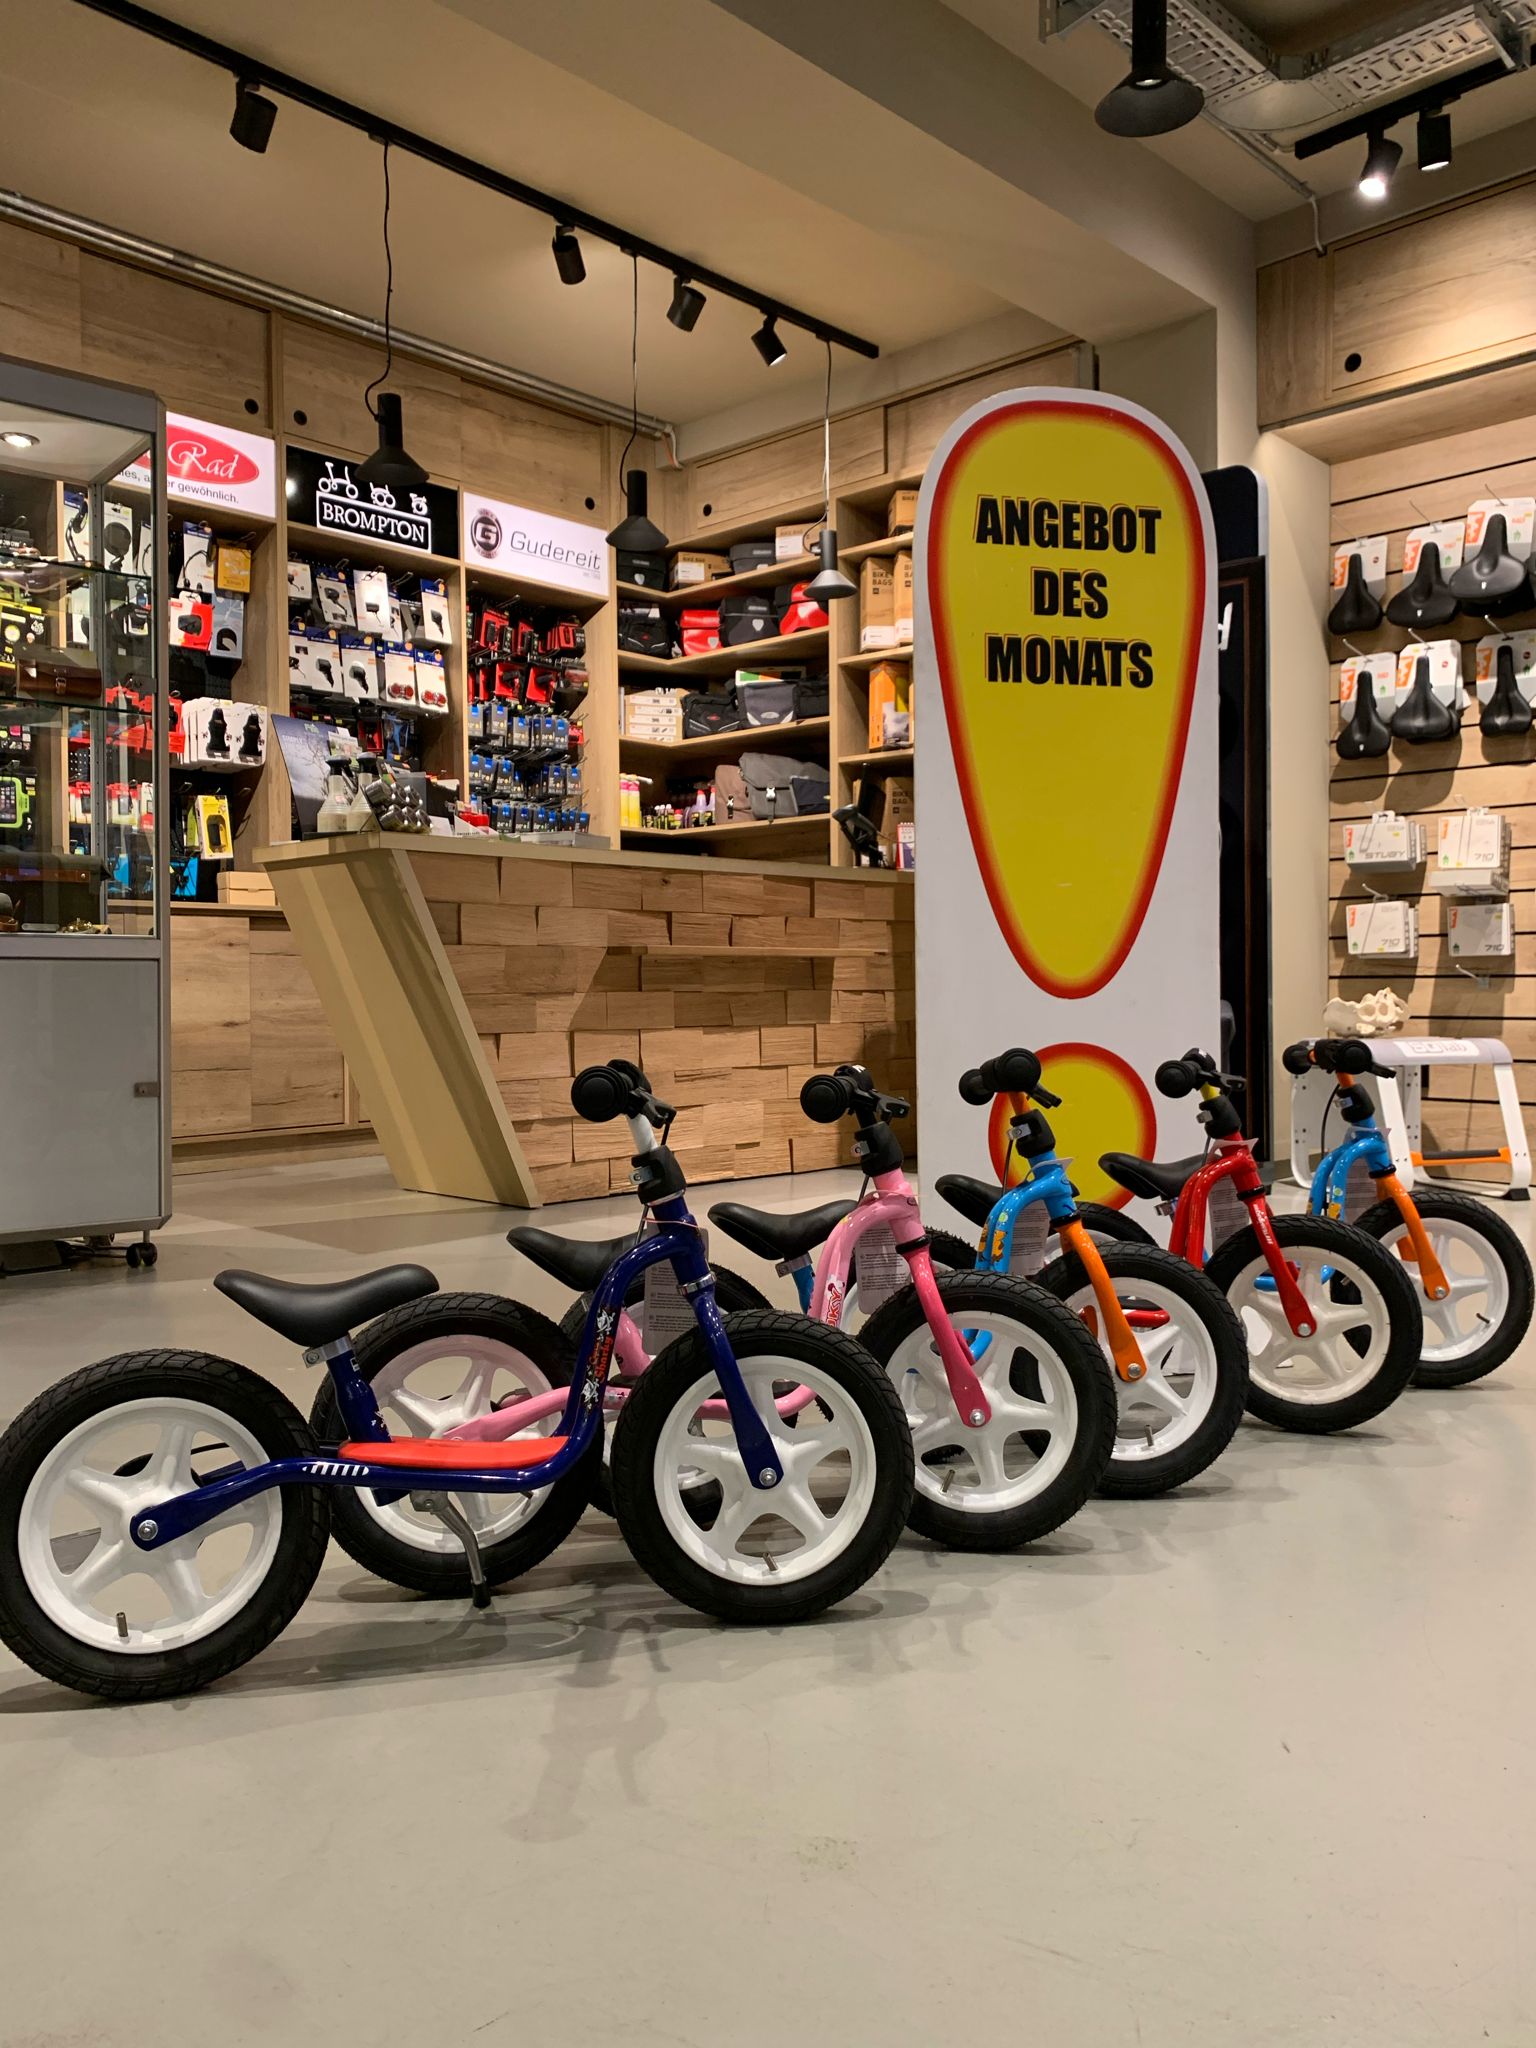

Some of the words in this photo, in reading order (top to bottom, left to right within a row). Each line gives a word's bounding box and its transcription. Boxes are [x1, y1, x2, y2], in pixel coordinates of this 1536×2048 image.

[168, 440, 239, 479] Rad
[178, 482, 239, 504] gewöhnlich.
[322, 502, 425, 543] BROMPTON
[973, 494, 1161, 554] ANGEBOT
[510, 530, 602, 570] Gudereit
[1031, 567, 1108, 619] DES
[985, 632, 1154, 688] MONATS
